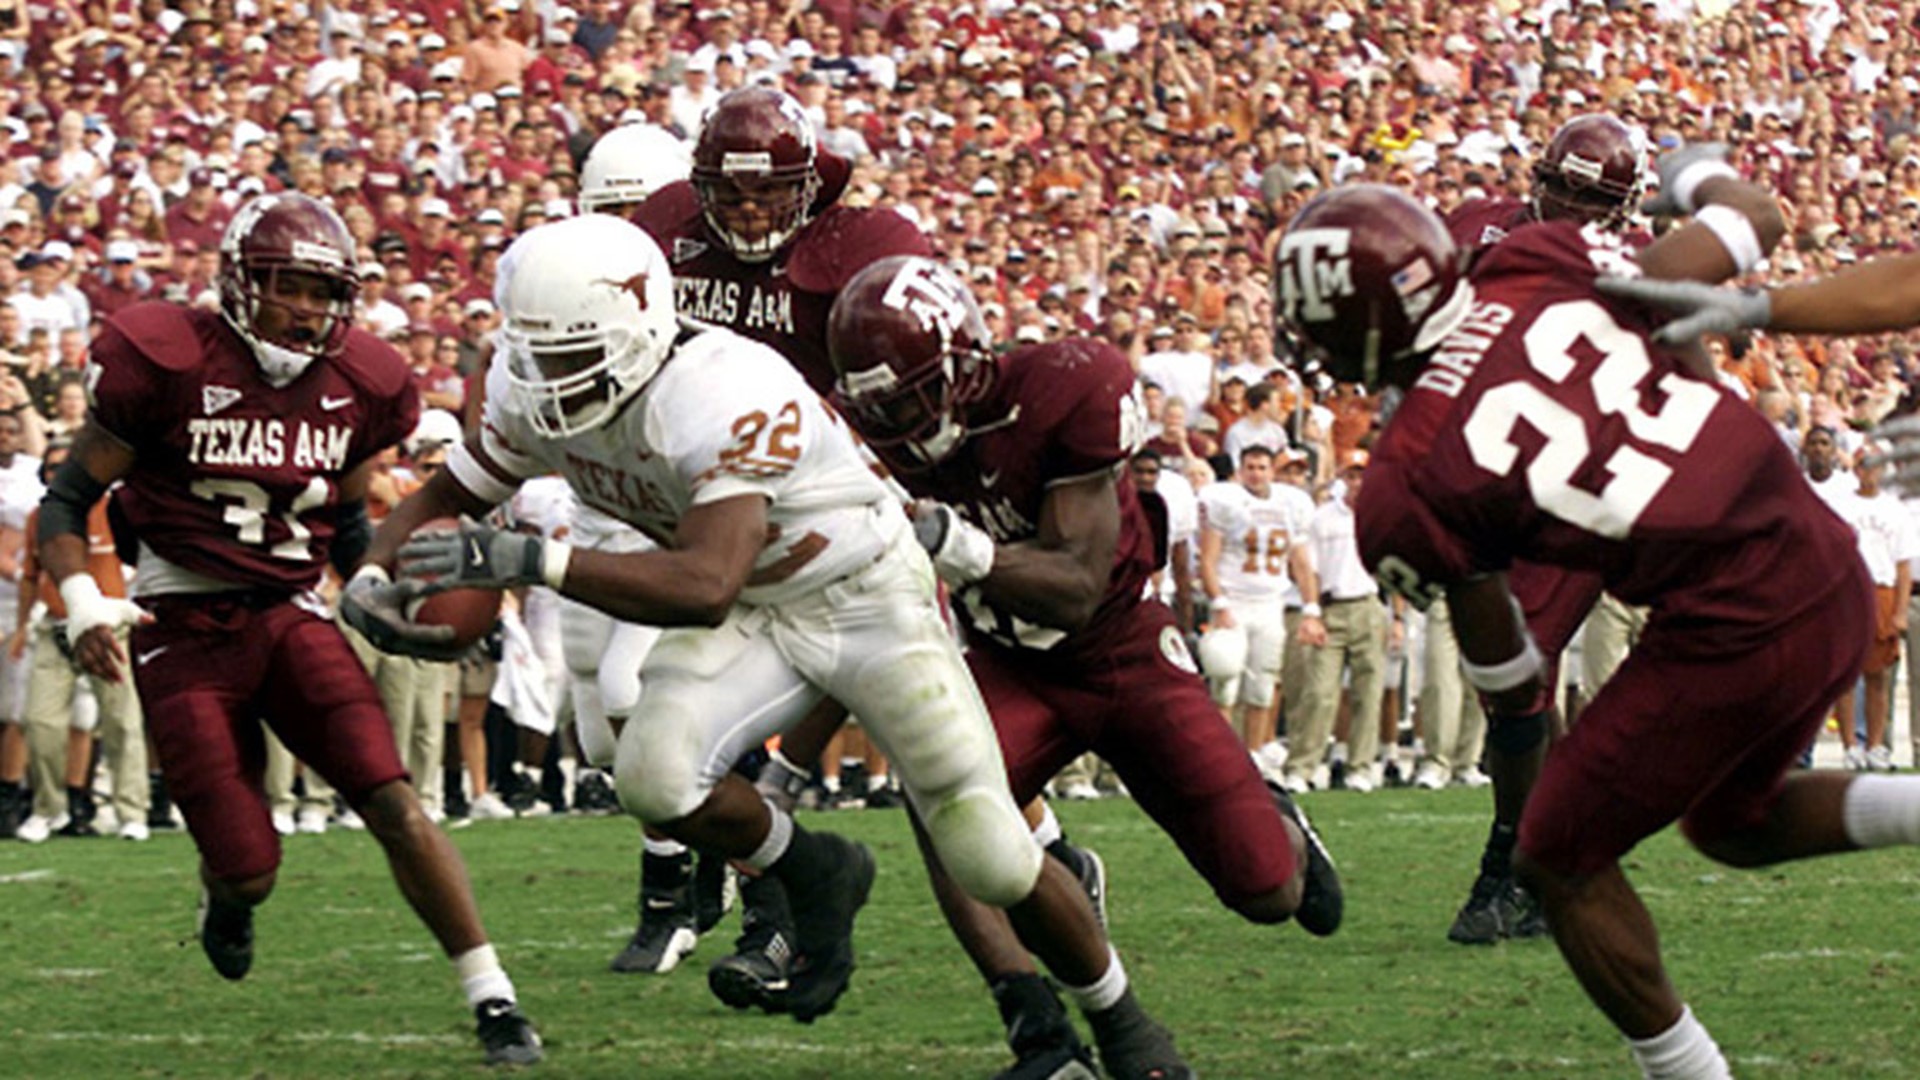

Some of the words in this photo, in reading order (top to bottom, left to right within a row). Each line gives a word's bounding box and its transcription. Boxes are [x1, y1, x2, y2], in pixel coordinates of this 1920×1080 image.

[745, 284, 795, 334] A&M
[1415, 301, 1514, 398] DAVIS
[188, 418, 284, 466] TEXAS
[293, 420, 352, 470] A&M
[1463, 299, 1721, 540] 22
